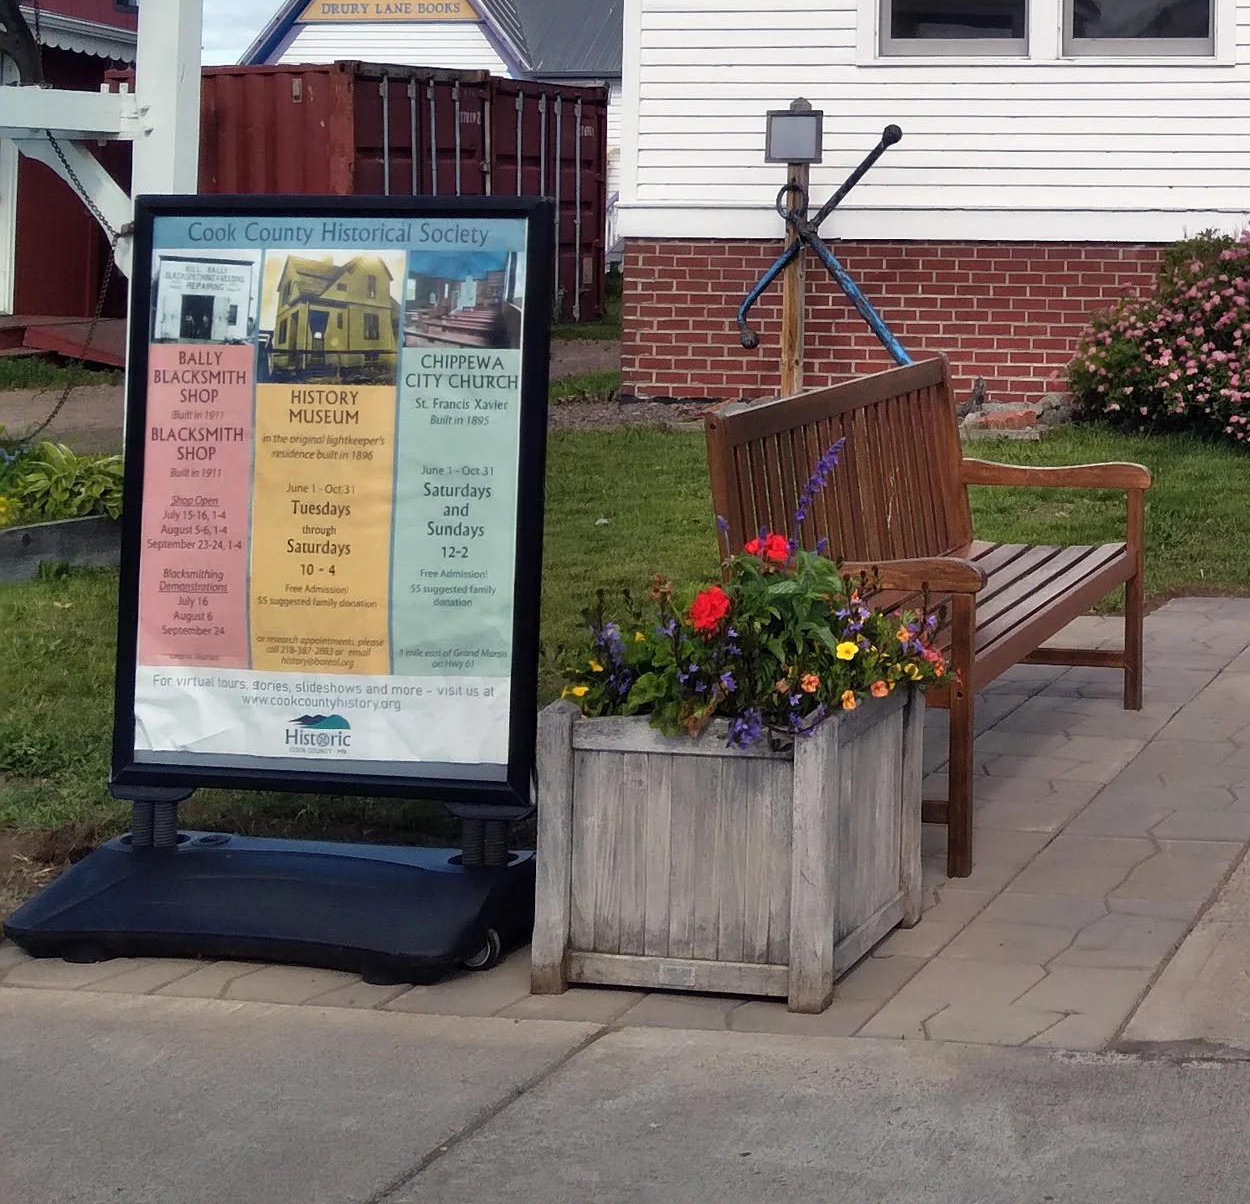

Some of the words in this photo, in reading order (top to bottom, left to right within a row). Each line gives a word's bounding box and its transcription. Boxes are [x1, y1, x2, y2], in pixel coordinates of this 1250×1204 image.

[321, 3, 369, 14] DRURY
[375, 3, 412, 14] LANE
[418, 3, 461, 13] BOOKS
[188, 222, 236, 242] Cook
[244, 222, 314, 245] County
[321, 222, 411, 243] Historical
[419, 222, 490, 248] Society
[178, 351, 223, 366] BALLY
[420, 354, 505, 370] CHIPPEWA
[154, 369, 247, 385] BLACKSMITH
[405, 373, 443, 388] CITY
[448, 374, 518, 390] CHURCH
[180, 389, 219, 403] SHOP
[291, 389, 359, 405] HISTORY
[415, 397, 428, 409] St.
[433, 398, 470, 410] Francis
[474, 399, 508, 410] Xavier
[171, 410, 192, 420] Built
[194, 410, 202, 420] in
[205, 410, 225, 420] 1911
[289, 409, 359, 425] MUSEUM
[430, 414, 451, 425] Built
[454, 415, 463, 425] in
[467, 416, 490, 425] 1895
[151, 427, 244, 442] BLACKSMITH
[262, 434, 272, 443] in
[272, 434, 288, 444] the
[289, 435, 325, 447] original
[326, 436, 385, 447] lightkeeper's
[177, 446, 217, 461] SHOP
[271, 449, 315, 460] residence
[316, 450, 338, 460] built
[340, 450, 349, 460] in
[351, 451, 374, 461] 1896
[169, 467, 190, 478] Built
[191, 468, 200, 478] in
[202, 468, 222, 478] 1911
[421, 465, 445, 476] June
[448, 466, 452, 475] 1
[461, 466, 480, 476] Oct
[482, 467, 494, 476] 31
[286, 483, 309, 494] June
[312, 484, 316, 493] 1
[325, 484, 342, 494] Oct
[344, 485, 355, 494] 31
[424, 482, 492, 500] Saturdays
[171, 496, 194, 506] Shop
[194, 496, 219, 507] Open
[291, 500, 351, 518] Tuesdays
[443, 503, 469, 517] and
[162, 510, 180, 521] July
[183, 510, 210, 521] 15-16,
[212, 511, 226, 520] 1-4
[161, 525, 193, 536] August
[195, 525, 211, 535] 5-6,
[214, 525, 228, 534] 1-4
[302, 525, 337, 536] through
[427, 521, 485, 539] Sundays
[146, 539, 196, 550] September
[198, 539, 226, 550] 23-24,
[228, 540, 242, 550] 1-4
[287, 539, 351, 557] Saturdays
[441, 546, 469, 558] 12-2
[163, 568, 224, 582] Blacksmithing
[300, 563, 314, 576] 10
[328, 564, 336, 576] 4
[420, 569, 439, 578] Free
[440, 569, 489, 579] Admission!
[158, 581, 228, 593] Demonstrations
[284, 583, 303, 593] Free
[423, 585, 468, 596] suggested
[469, 585, 497, 596] family
[177, 596, 195, 607] July
[198, 597, 209, 607] 16
[269, 597, 312, 608] suggested
[312, 598, 338, 609] family
[339, 599, 377, 608] donation
[432, 597, 473, 607] donation
[173, 611, 205, 623] August
[207, 612, 213, 621] 6
[161, 625, 212, 637] September
[214, 626, 225, 636] 24
[357, 638, 384, 647] please
[405, 648, 424, 657] mile
[453, 649, 479, 658] Grand
[445, 659, 464, 669] Hwy
[465, 659, 475, 668] 61
[153, 674, 173, 686] For
[177, 676, 216, 688] virtual
[217, 677, 249, 691] tours,
[295, 682, 363, 695] slideshows
[366, 683, 388, 695] and
[391, 686, 423, 696] more
[437, 685, 462, 696] visit
[465, 687, 479, 697] us
[483, 686, 495, 697] at
[241, 695, 401, 712] www.cookcountyhistory.org
[285, 728, 352, 747] Historic
